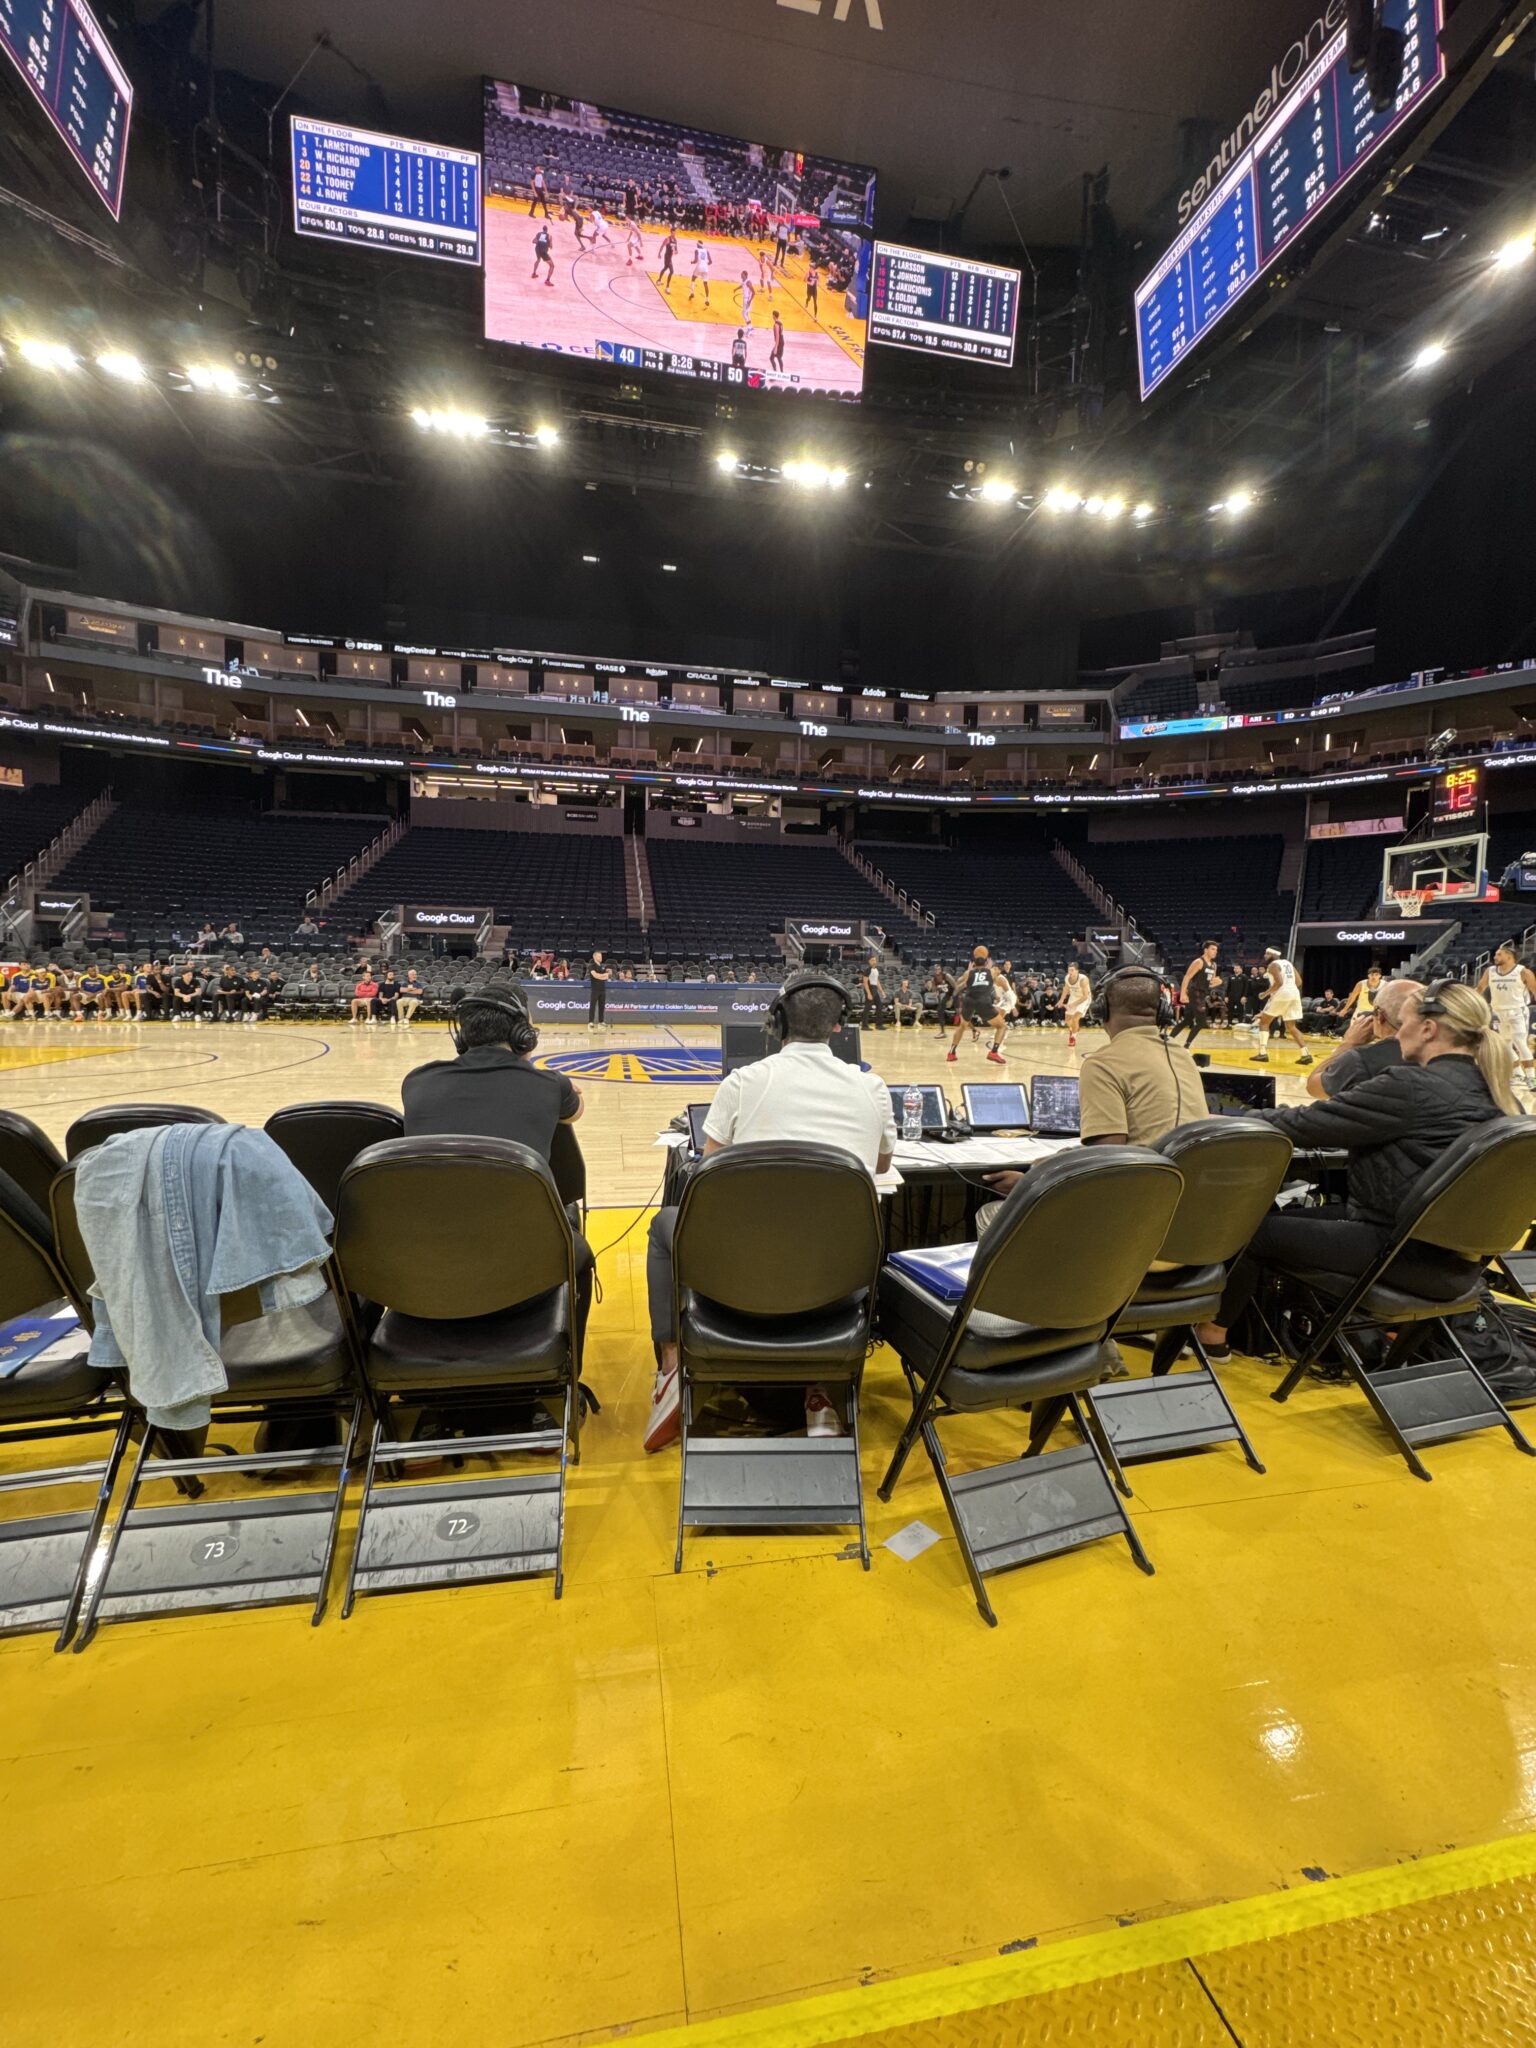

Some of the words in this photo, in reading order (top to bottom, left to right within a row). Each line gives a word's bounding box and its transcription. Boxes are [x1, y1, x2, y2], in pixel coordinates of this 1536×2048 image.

[1404, 12, 1417, 35] 16
[1404, 34, 1418, 60] 26
[1300, 66, 1322, 97] MIAMI
[1322, 35, 1344, 68] TEAM
[298, 122, 308, 130] ON
[311, 125, 325, 134] THE
[328, 128, 352, 138] FLOOR
[1270, 136, 1282, 158] AST
[1313, 88, 1320, 105] 9
[1270, 148, 1289, 174] OREB
[1314, 107, 1321, 121] 4
[1312, 125, 1322, 145] 13
[315, 137, 322, 148] T.
[324, 139, 370, 157] ARMSTRONG
[390, 141, 404, 149] PTS
[413, 146, 427, 154] REB
[1316, 144, 1323, 159] 5
[315, 150, 325, 161] W.
[326, 152, 360, 167] RICHARD
[300, 159, 310, 170] 20
[315, 162, 325, 173] M.
[326, 165, 356, 179] BOLDEN
[316, 175, 323, 185] A.
[325, 176, 354, 190] TOOHEY
[301, 184, 311, 194] 44
[317, 187, 324, 197] J.
[325, 189, 348, 202] ROWE
[394, 202, 403, 212] 12
[301, 202, 321, 211] FOUR
[323, 205, 358, 218] FACTORS
[301, 216, 323, 228] EFG%
[325, 219, 343, 232] 50.0
[348, 225, 365, 235] TO%
[389, 233, 416, 244] OREB%
[440, 242, 453, 251] FTR
[456, 244, 473, 256] 29.0
[1158, 251, 1176, 278] GOLDEN
[1176, 233, 1191, 255] STATE
[1206, 190, 1224, 217] STATS
[898, 260, 925, 274] LARSSON
[897, 271, 925, 285] JOHNSON
[1227, 269, 1246, 296] 100.0
[896, 292, 917, 304] GOLDIN
[895, 302, 914, 314] LEWIS
[619, 347, 635, 363] 40
[646, 351, 656, 359] TOL
[671, 354, 693, 369] 8:26
[701, 361, 712, 369] TOL
[700, 370, 711, 378] FLS
[728, 368, 742, 382] 50
[357, 642, 382, 651] PEPSI
[394, 645, 436, 655] RingCentral
[497, 655, 517, 664] Google
[595, 664, 618, 672] CHASE
[202, 667, 242, 688] The
[687, 672, 718, 680] ORACLE
[423, 691, 456, 707] The
[862, 688, 886, 697] Adobe
[620, 707, 650, 722] The
[13, 719, 38, 729] Cloud
[800, 721, 828, 737] The
[968, 732, 996, 746] The
[257, 750, 282, 760] Google
[284, 752, 302, 760] Cloud
[1484, 757, 1515, 767] Google
[476, 764, 498, 773] Google
[676, 778, 696, 786] Google
[1446, 769, 1476, 788] 8:25
[858, 789, 877, 798] Google
[1450, 784, 1472, 809] 12
[1445, 810, 1475, 820] TISSOT
[416, 912, 448, 925] Google
[450, 913, 474, 923] Cloud
[802, 925, 827, 936] Google
[829, 926, 851, 934] Cloud
[1337, 931, 1372, 941] Google
[1374, 931, 1404, 940] Cloud
[974, 972, 987, 980] 16
[537, 1001, 565, 1010] Google
[732, 1002, 758, 1012] Google
[448, 1519, 474, 1536] 72
[203, 1542, 225, 1560] 73
